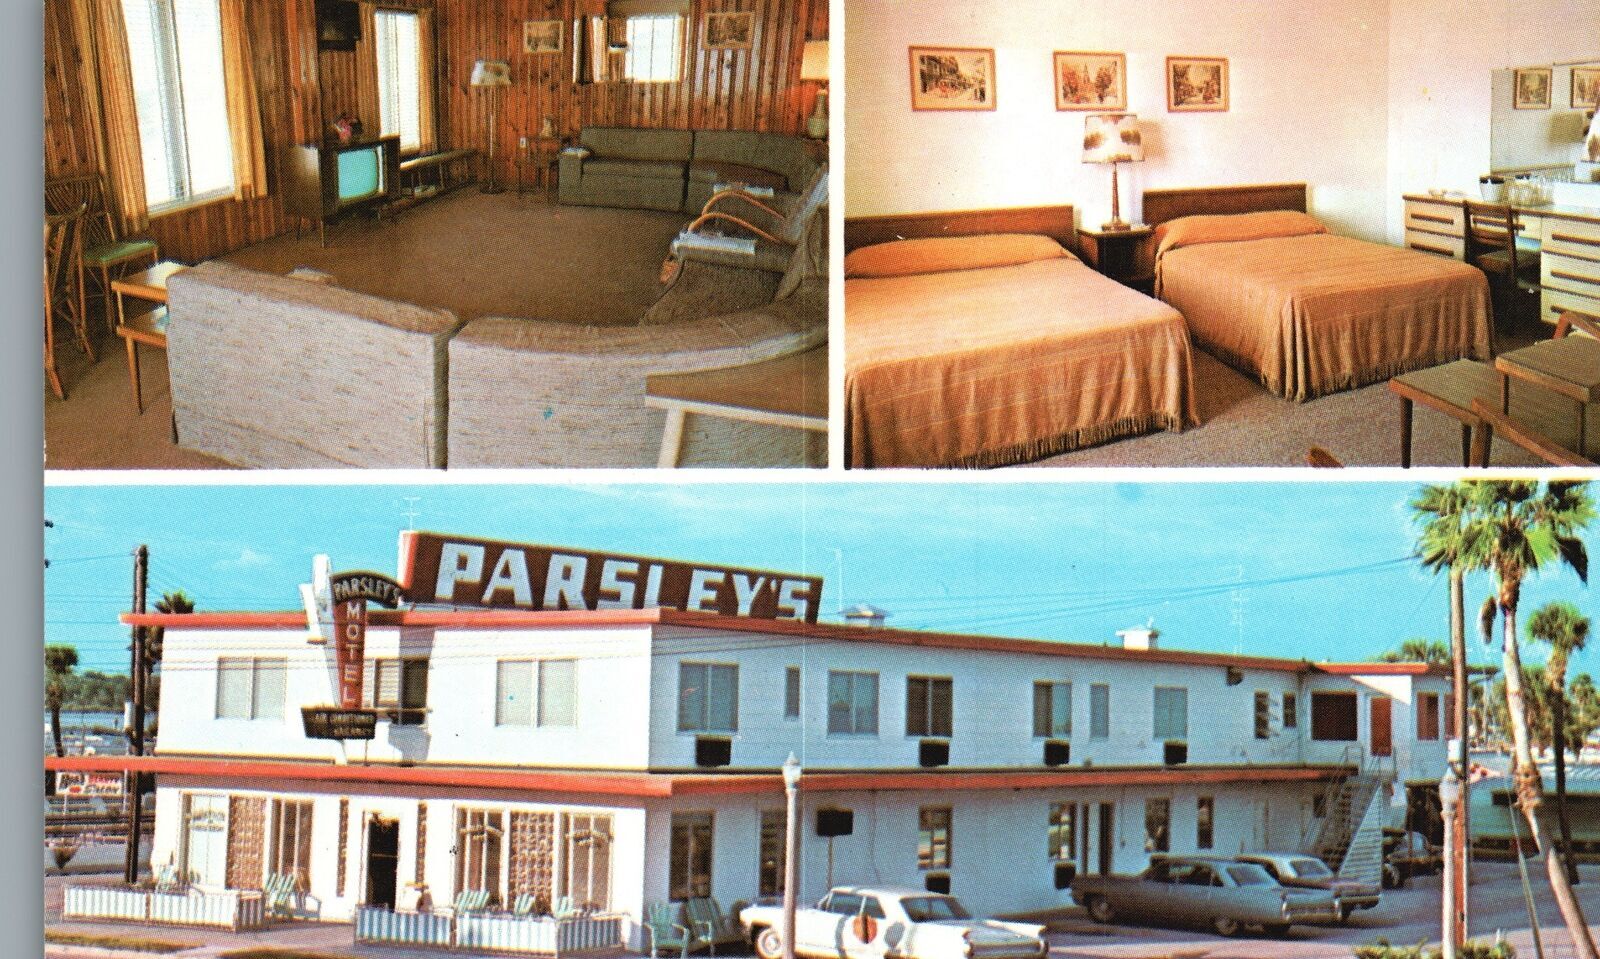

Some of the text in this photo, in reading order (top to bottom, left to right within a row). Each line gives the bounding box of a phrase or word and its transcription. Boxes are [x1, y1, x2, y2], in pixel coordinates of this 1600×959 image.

[334, 577, 400, 604] PARSLEY'S
[435, 542, 811, 622] PARSLEY'S
[343, 602, 361, 702] MOTEL
